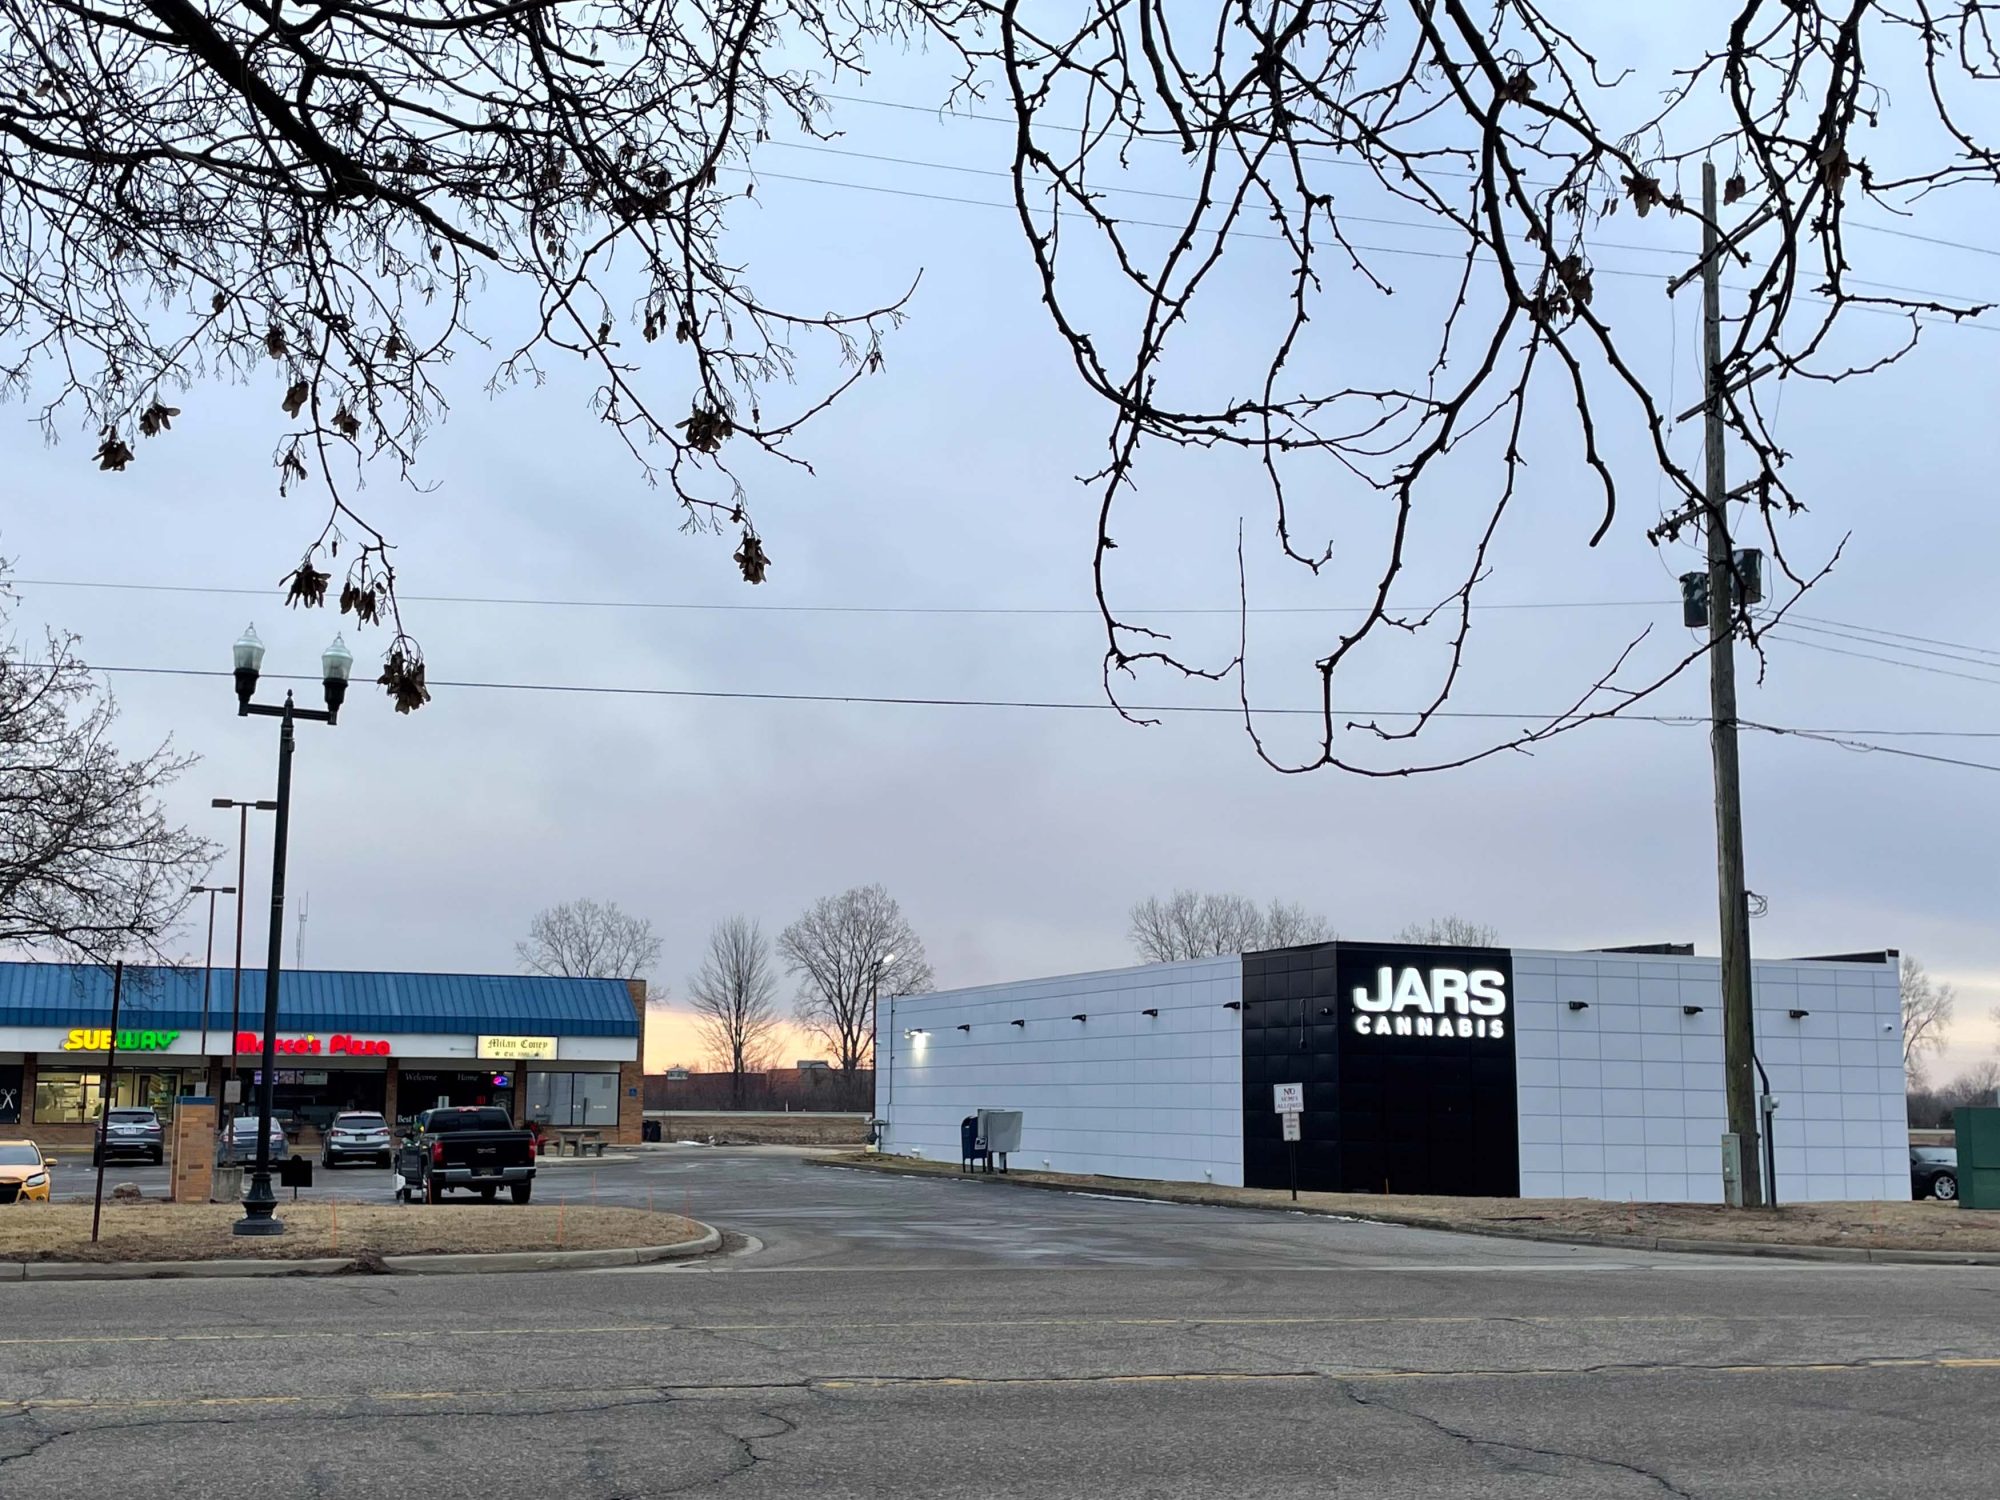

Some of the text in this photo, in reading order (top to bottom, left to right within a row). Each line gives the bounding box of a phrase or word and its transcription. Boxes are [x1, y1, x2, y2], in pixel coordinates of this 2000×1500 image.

[1353, 967, 1506, 1016] JARS
[1354, 1015, 1504, 1039] CANNABIS
[329, 1034, 390, 1055] Pizza
[488, 1039, 548, 1050] Milan Coney
[405, 1072, 438, 1081] Welcome
[397, 1114, 412, 1123] Best
